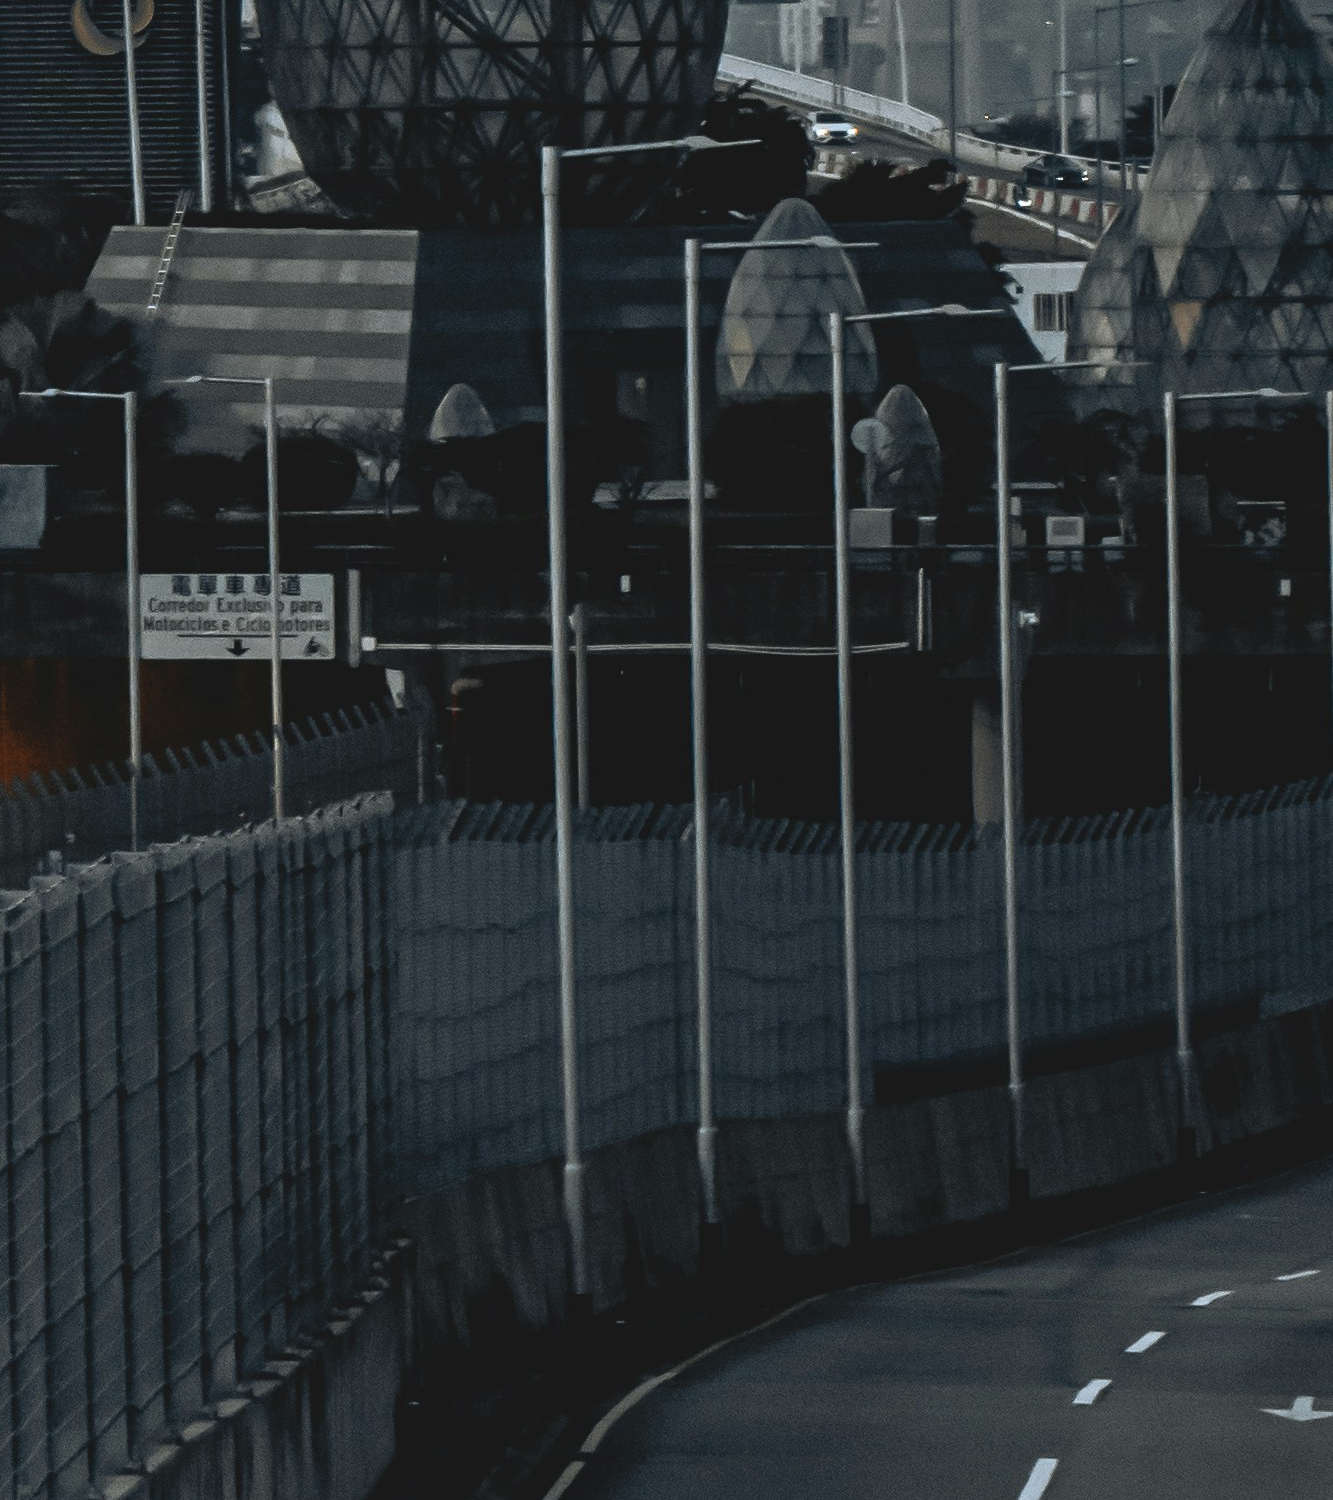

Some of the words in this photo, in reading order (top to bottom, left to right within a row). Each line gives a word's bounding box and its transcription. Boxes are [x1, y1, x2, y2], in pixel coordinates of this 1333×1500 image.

[148, 598, 209, 613] Corredor
[217, 598, 284, 613] Exclusio
[290, 600, 323, 614] para
[143, 616, 219, 631] Motociclos
